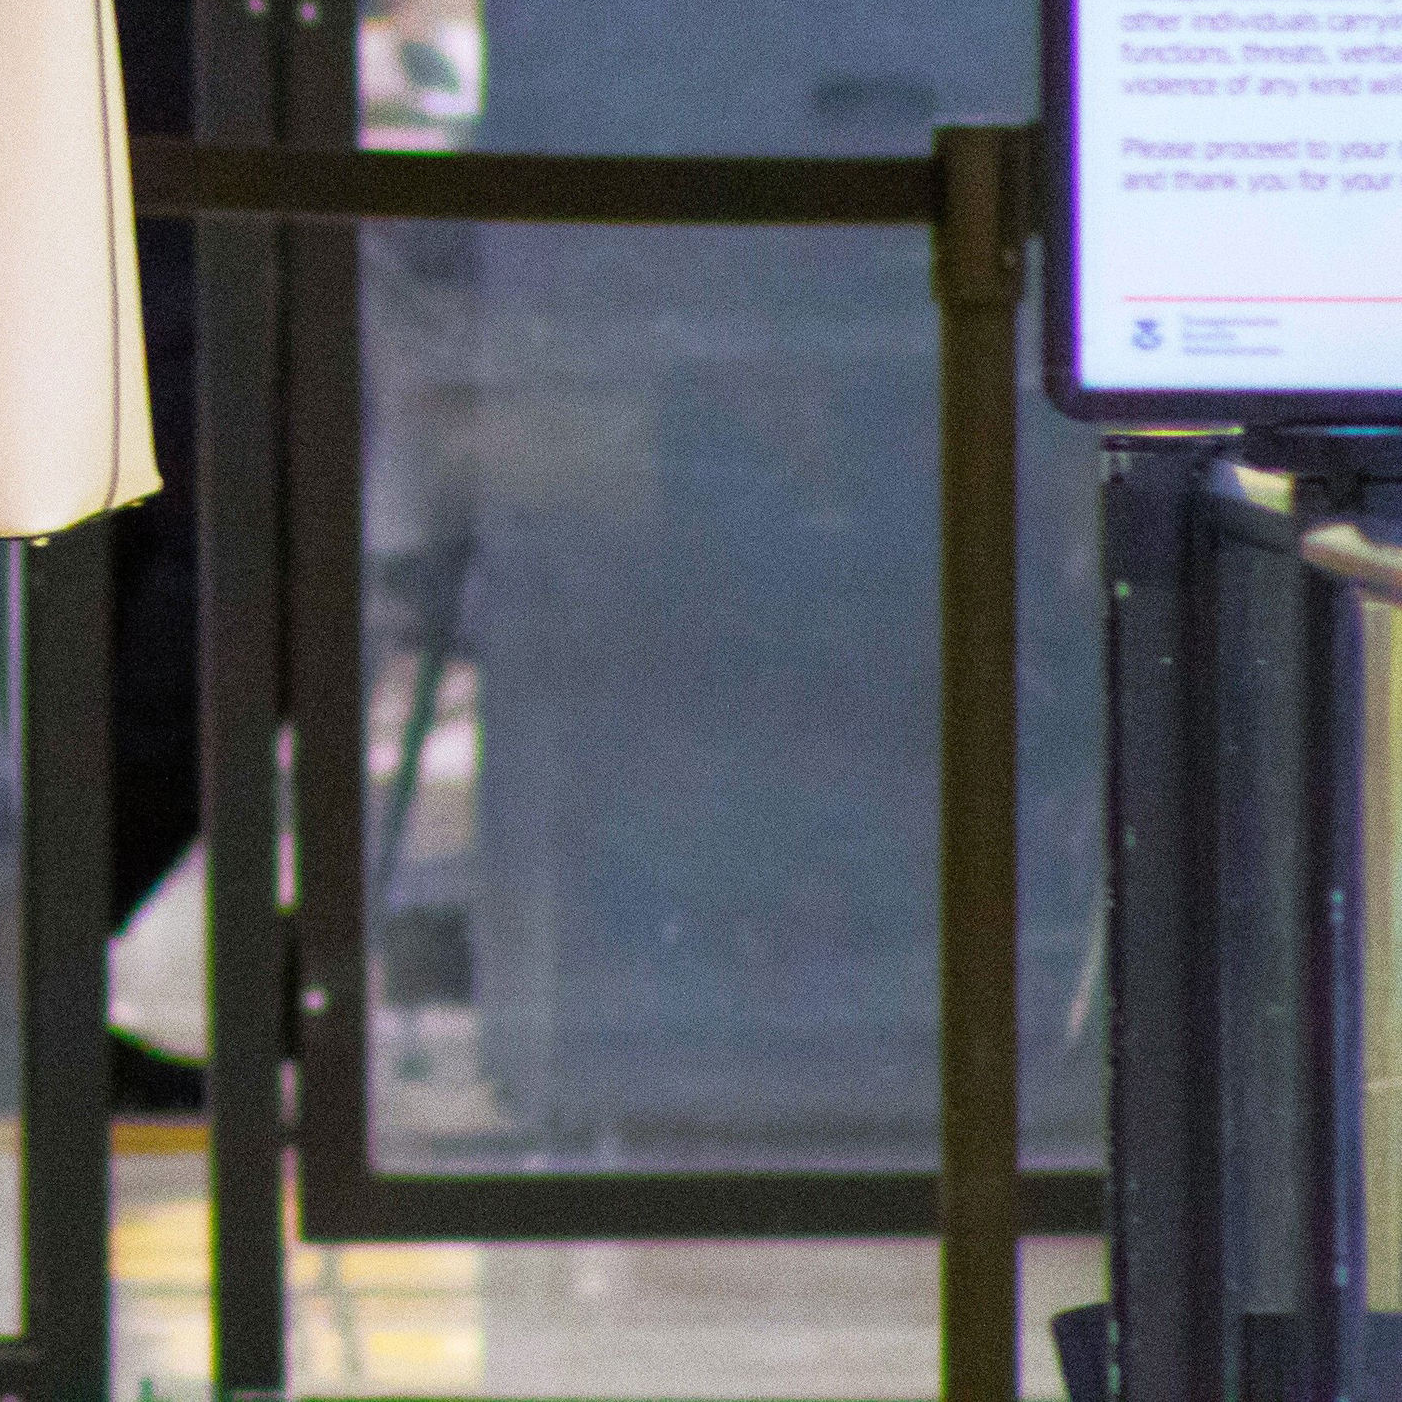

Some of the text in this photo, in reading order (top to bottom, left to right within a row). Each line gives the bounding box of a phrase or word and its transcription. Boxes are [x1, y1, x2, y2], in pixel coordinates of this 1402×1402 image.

[1119, 12, 1182, 34] other
[1190, 12, 1320, 34] individuals
[1121, 74, 1218, 97] violence
[1225, 74, 1253, 97] of
[1259, 78, 1298, 97] any
[1308, 74, 1362, 97] kind
[1121, 137, 1390, 161] Please proceed to your
[1122, 172, 1167, 194] and
[1173, 170, 1238, 194] thank
[1298, 170, 1332, 194] for
[1339, 174, 1394, 194] your
